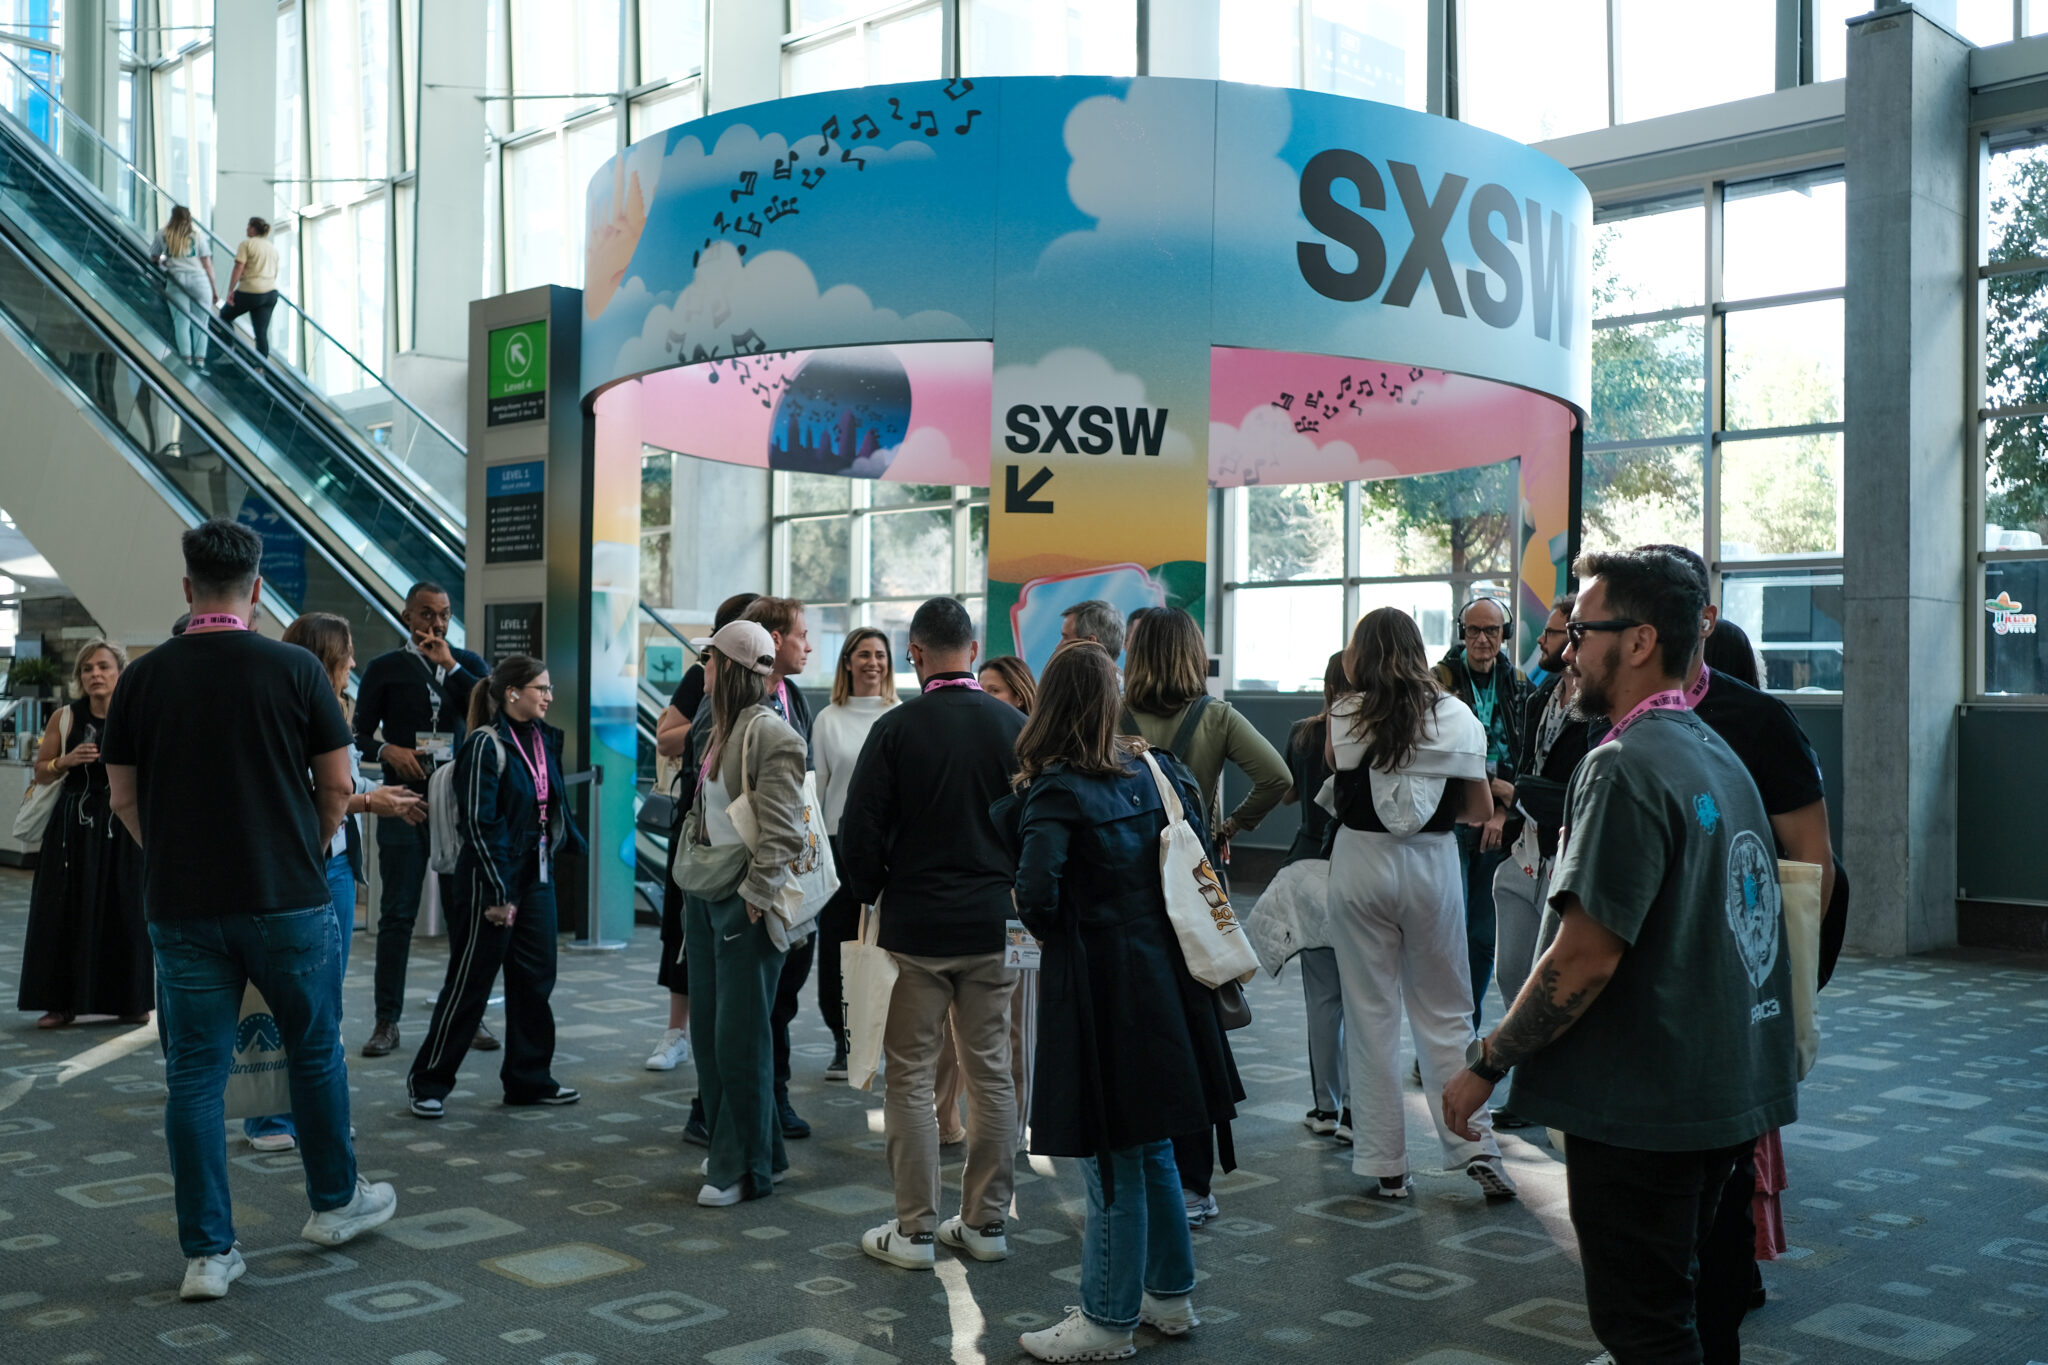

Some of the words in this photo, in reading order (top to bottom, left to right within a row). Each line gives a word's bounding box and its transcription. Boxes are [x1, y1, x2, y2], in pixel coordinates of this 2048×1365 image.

[1296, 148, 1578, 351] SXSW
[504, 380, 526, 392] Level
[1005, 404, 1169, 456] SXSW
[502, 469, 522, 481] LEVEL
[500, 619, 520, 630] LEVEL
[1211, 907, 1237, 922] 20
